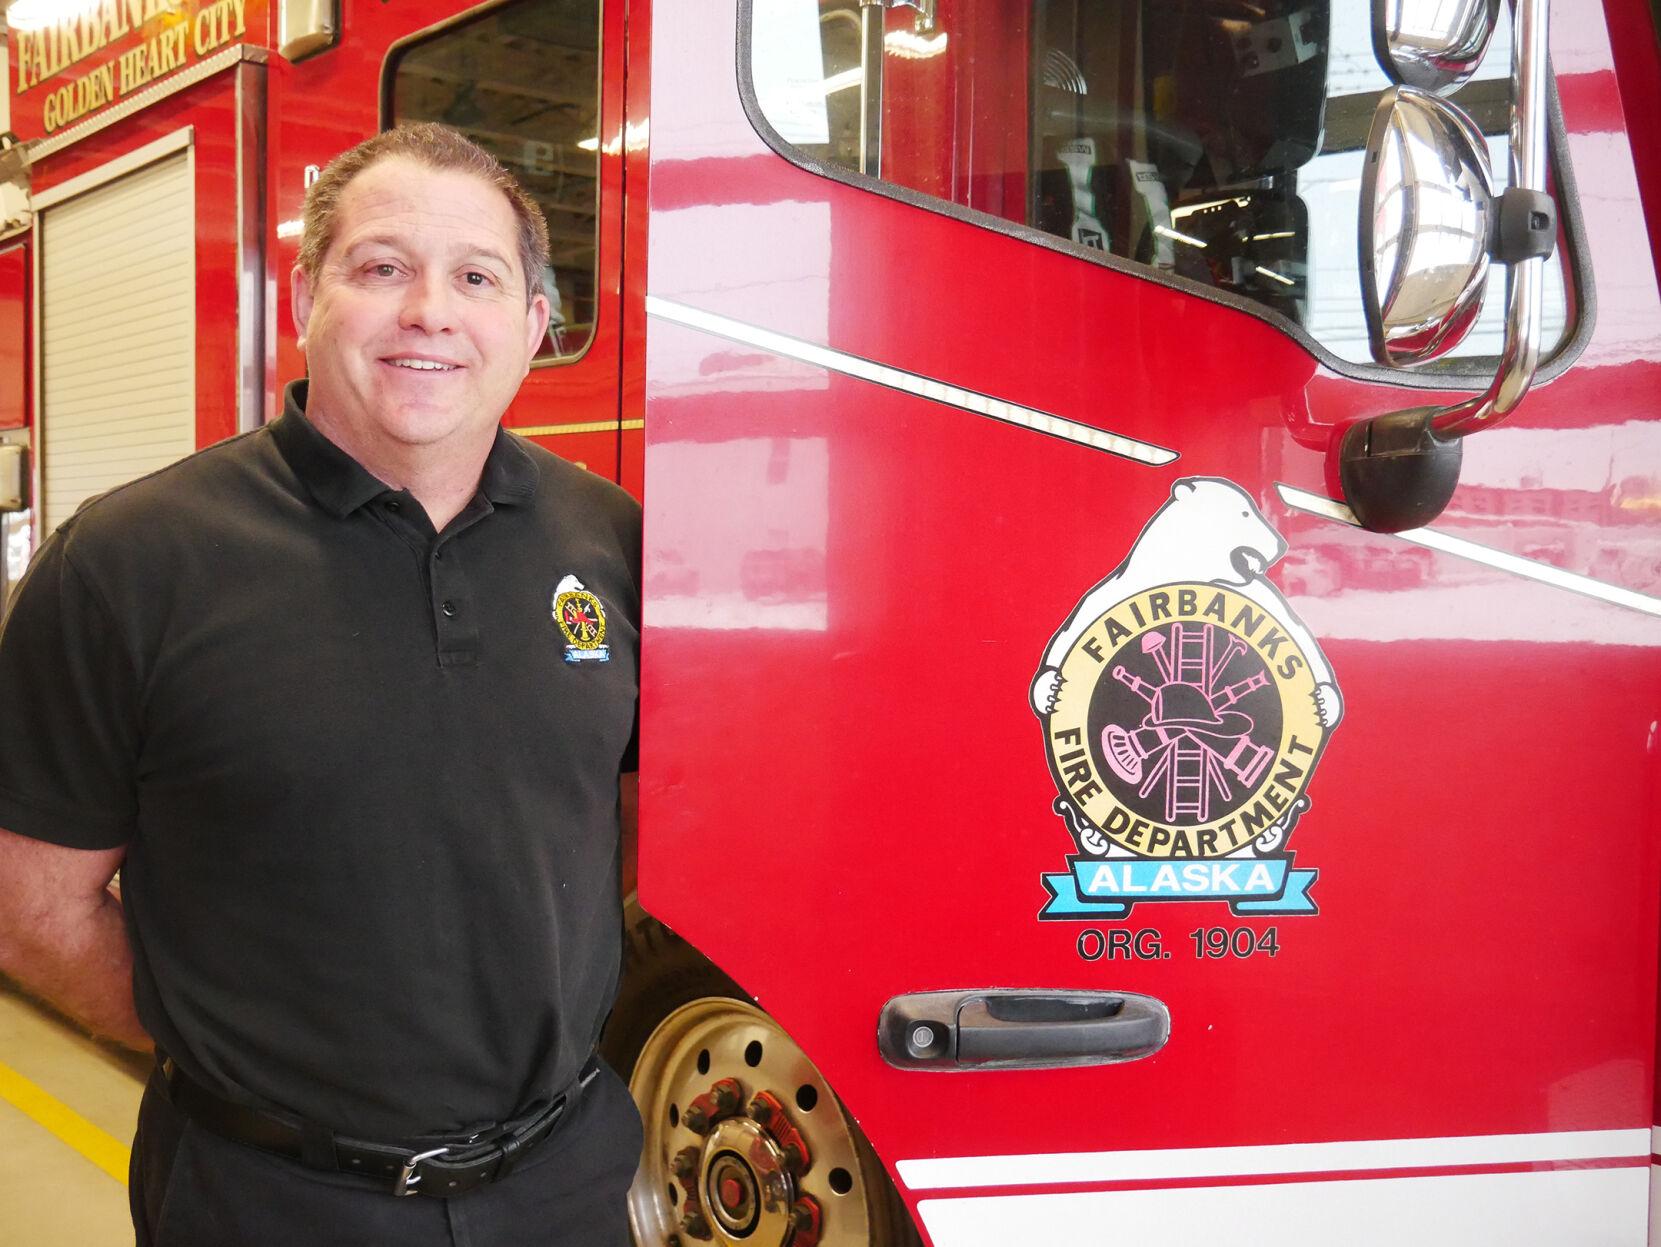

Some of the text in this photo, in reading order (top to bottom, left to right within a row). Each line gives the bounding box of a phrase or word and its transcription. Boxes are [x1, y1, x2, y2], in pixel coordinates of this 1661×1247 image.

[16, 0, 183, 95] FAIRBAN
[43, 0, 246, 134] GOLDEN HEART CITY
[1081, 589, 1304, 680] FAIRBANKS
[1054, 727, 1314, 857] FIRE DEPARTMENT
[1087, 864, 1276, 893] ALASKA
[1076, 926, 1280, 961] ORG. 1904
